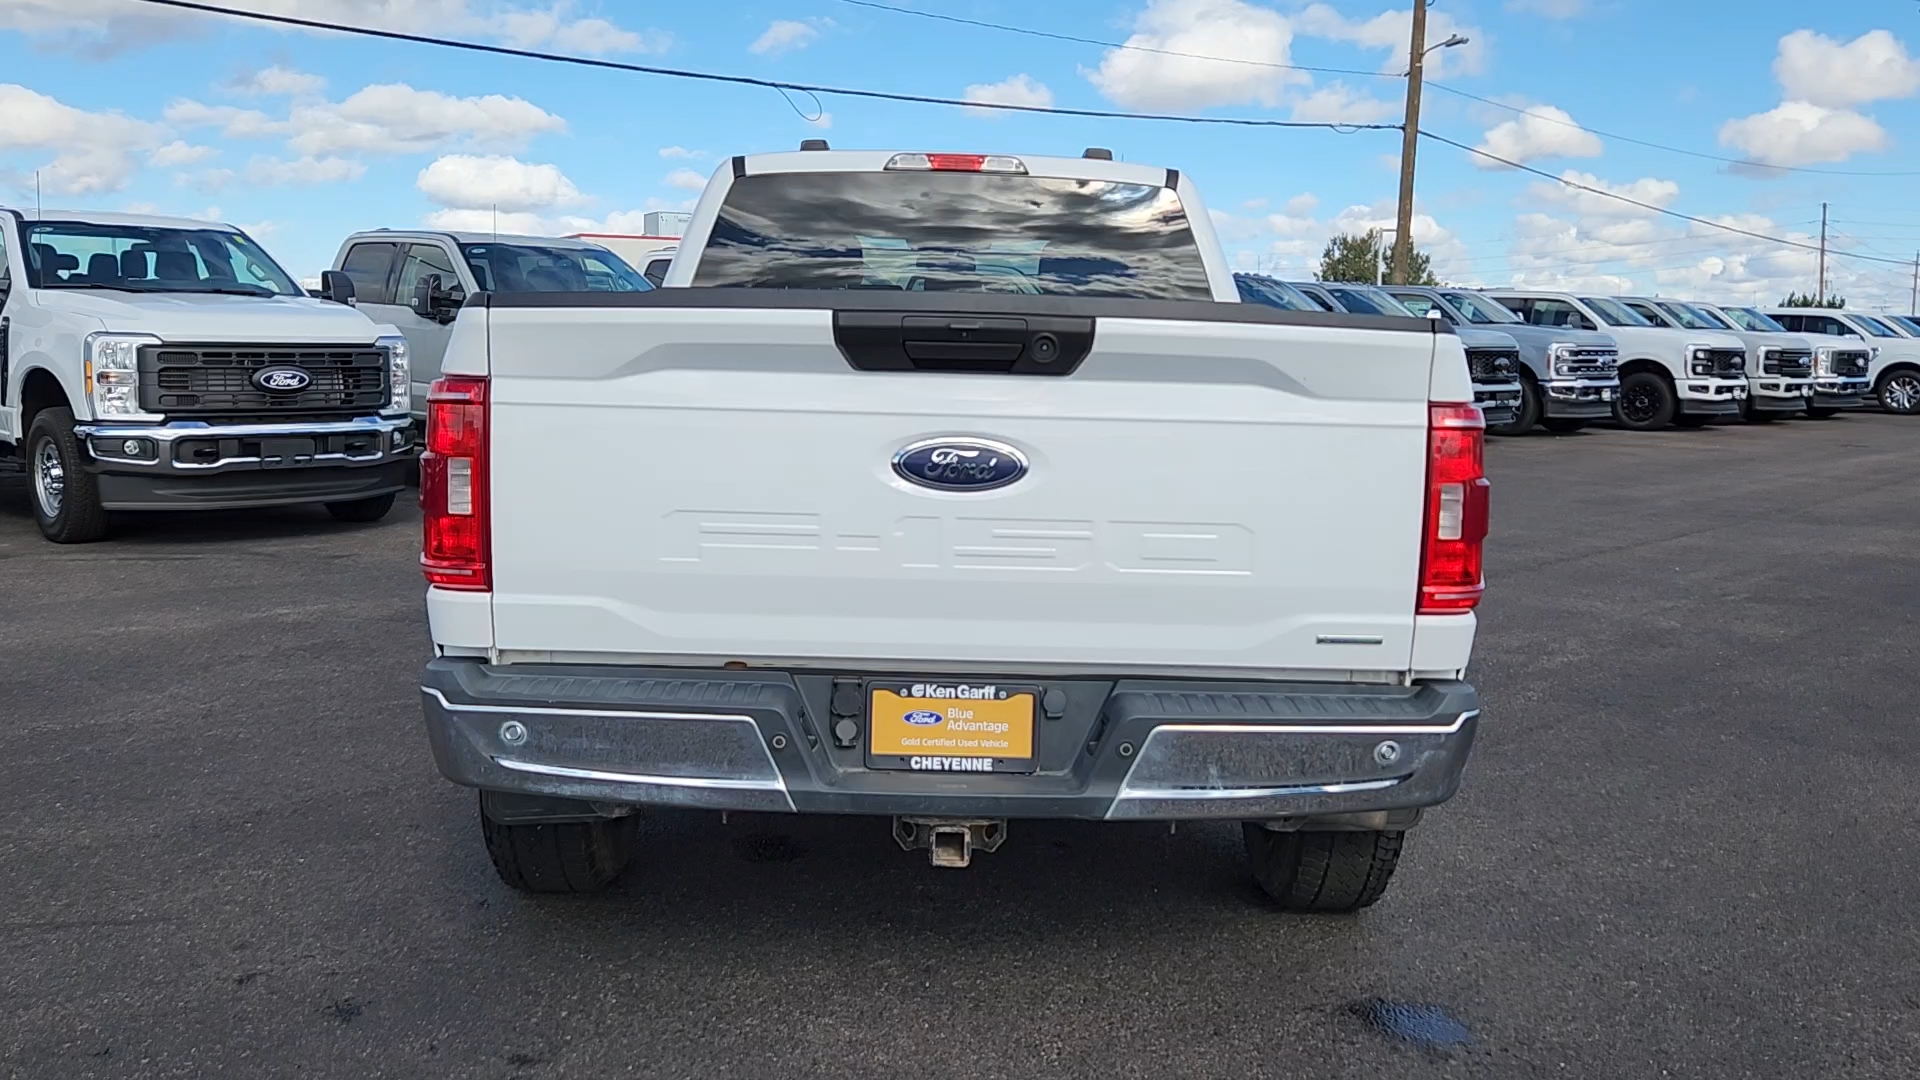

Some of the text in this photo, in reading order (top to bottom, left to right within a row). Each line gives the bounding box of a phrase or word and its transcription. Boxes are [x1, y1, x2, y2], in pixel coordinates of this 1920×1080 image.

[270, 373, 299, 385] Ford
[925, 684, 956, 698] Ken
[957, 685, 997, 700] Garff
[909, 711, 936, 723] Ford
[947, 708, 974, 719] Blue
[947, 721, 1009, 733] Advantage
[901, 738, 921, 746] Gold
[922, 739, 956, 747] Certified
[980, 740, 1009, 748] Vehicle
[910, 756, 993, 771] CHEYENNE
